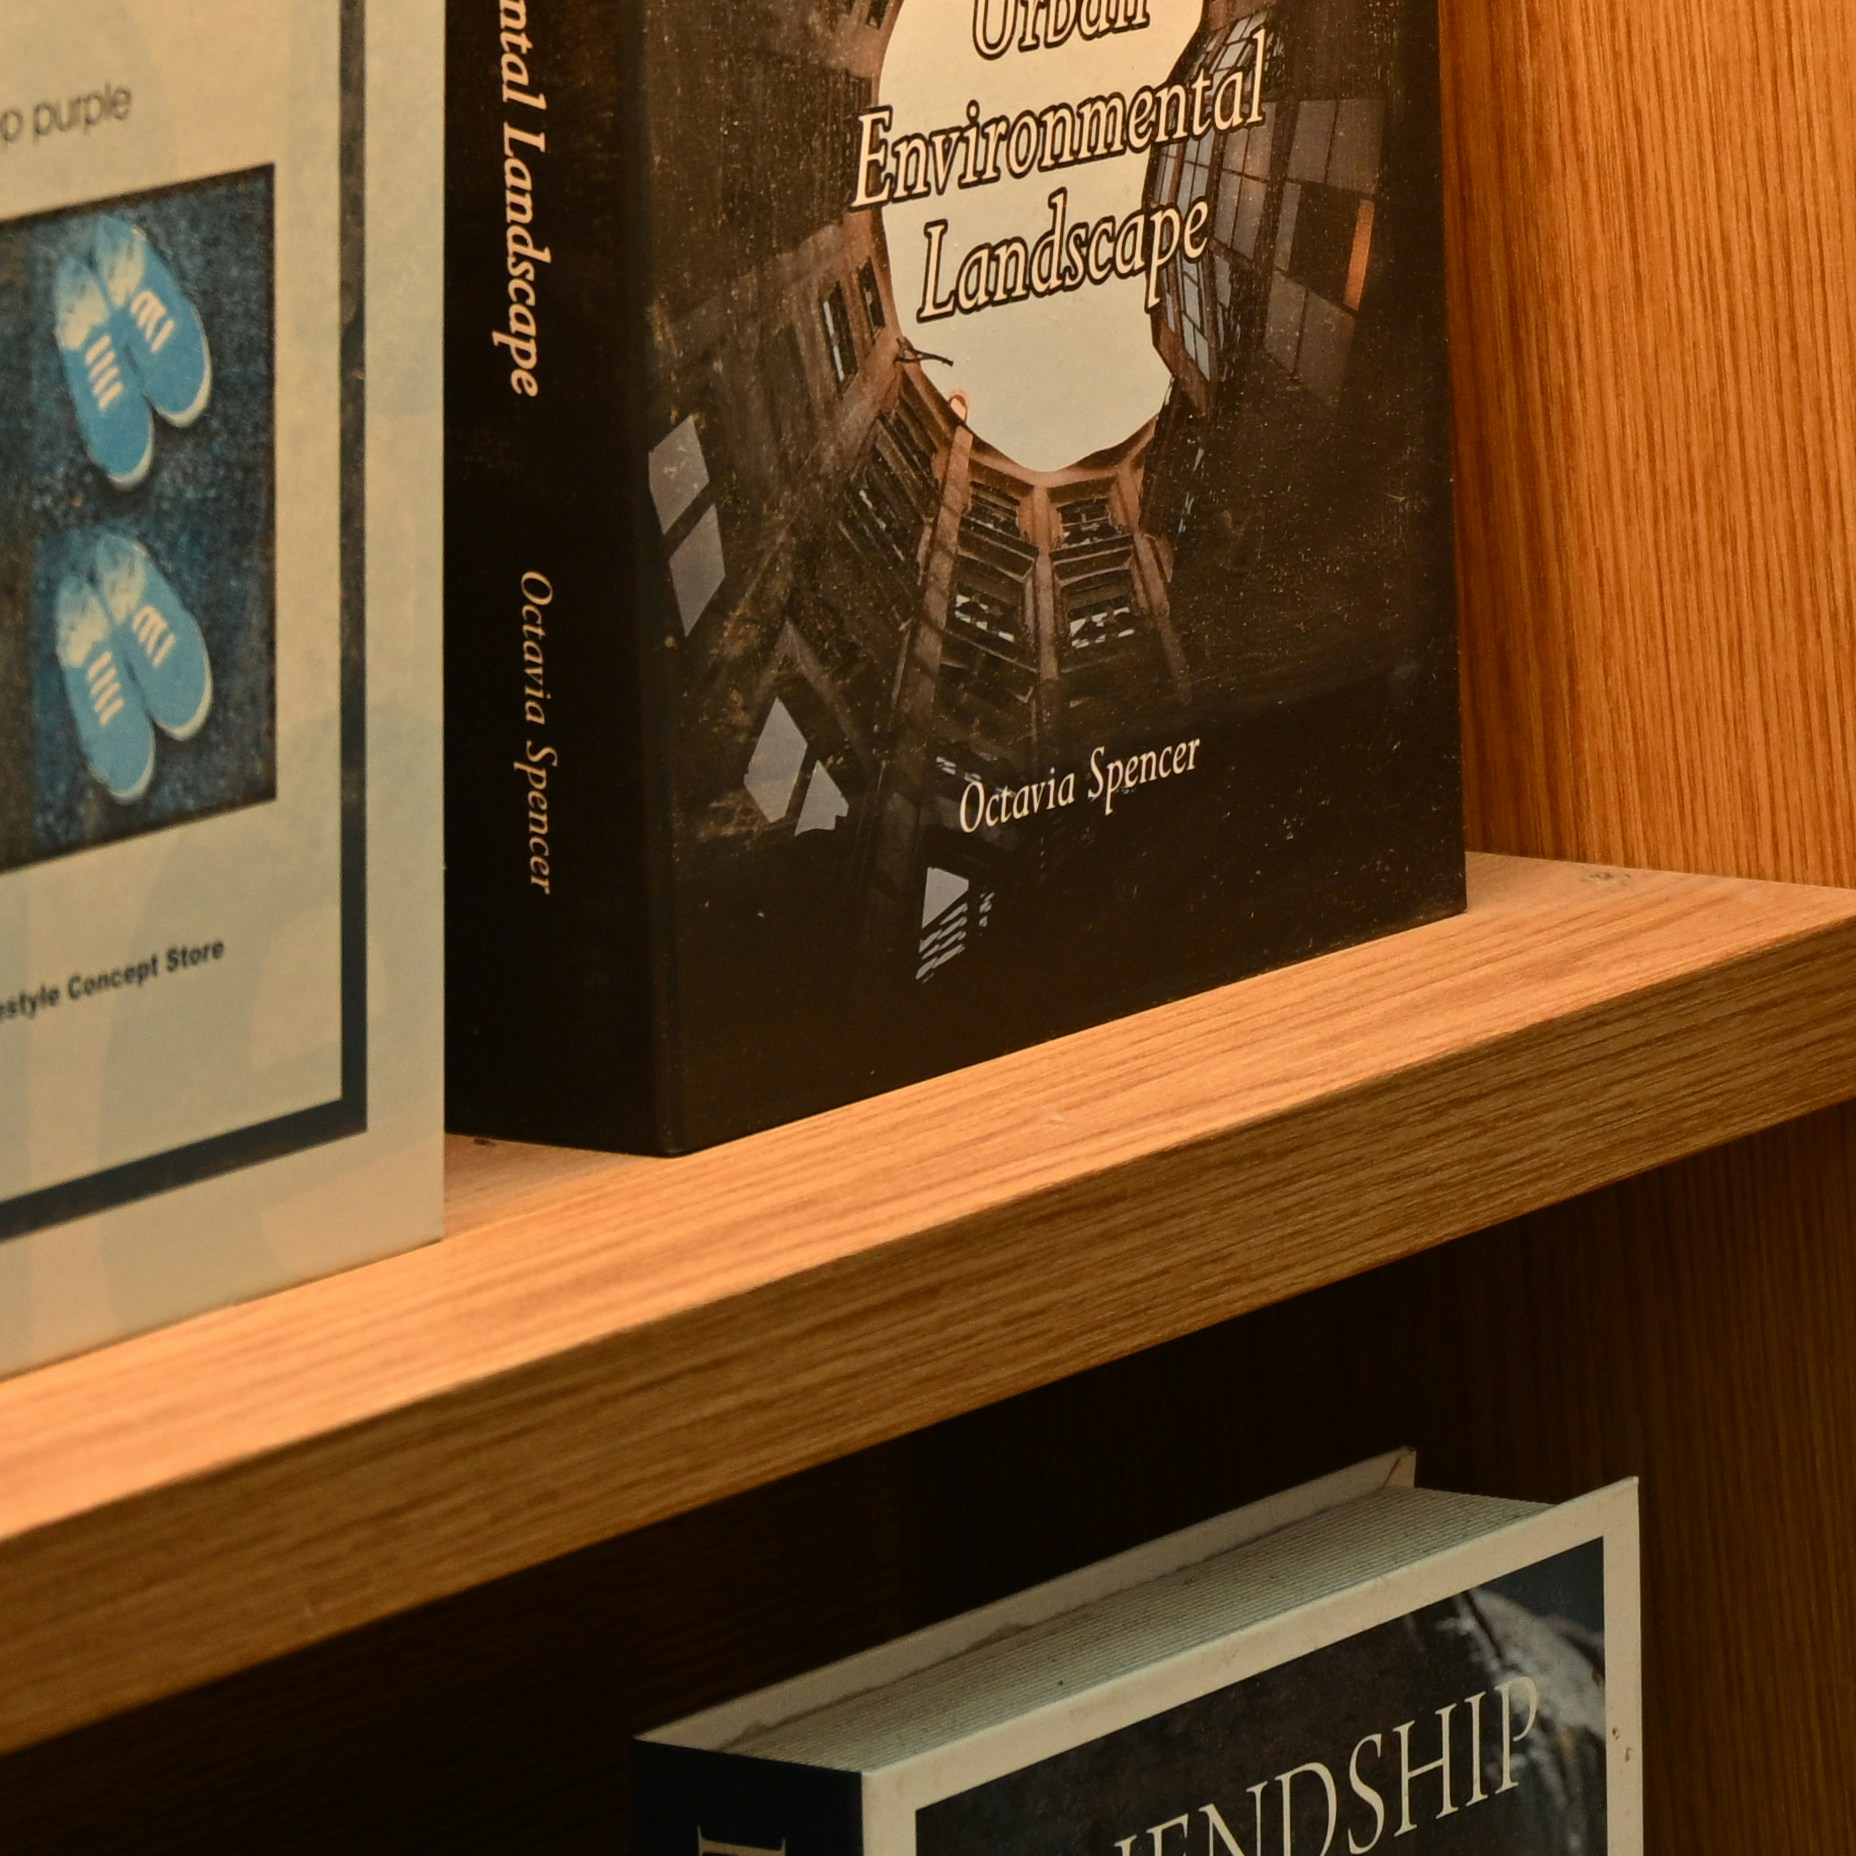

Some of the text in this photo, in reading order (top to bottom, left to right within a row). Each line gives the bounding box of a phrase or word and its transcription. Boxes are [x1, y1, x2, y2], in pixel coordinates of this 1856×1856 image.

[33, 82, 131, 143] purple
[849, 28, 1266, 207] Environmental
[492, 122, 551, 397] Landscape
[917, 189, 1208, 322] Landscape
[514, 571, 559, 893] Octavia Spencer
[960, 739, 1200, 833] Octavia Spencer
[67, 954, 158, 1000] Concept
[166, 940, 224, 972] Store
[1114, 1676, 1538, 1856] NDSHIP
